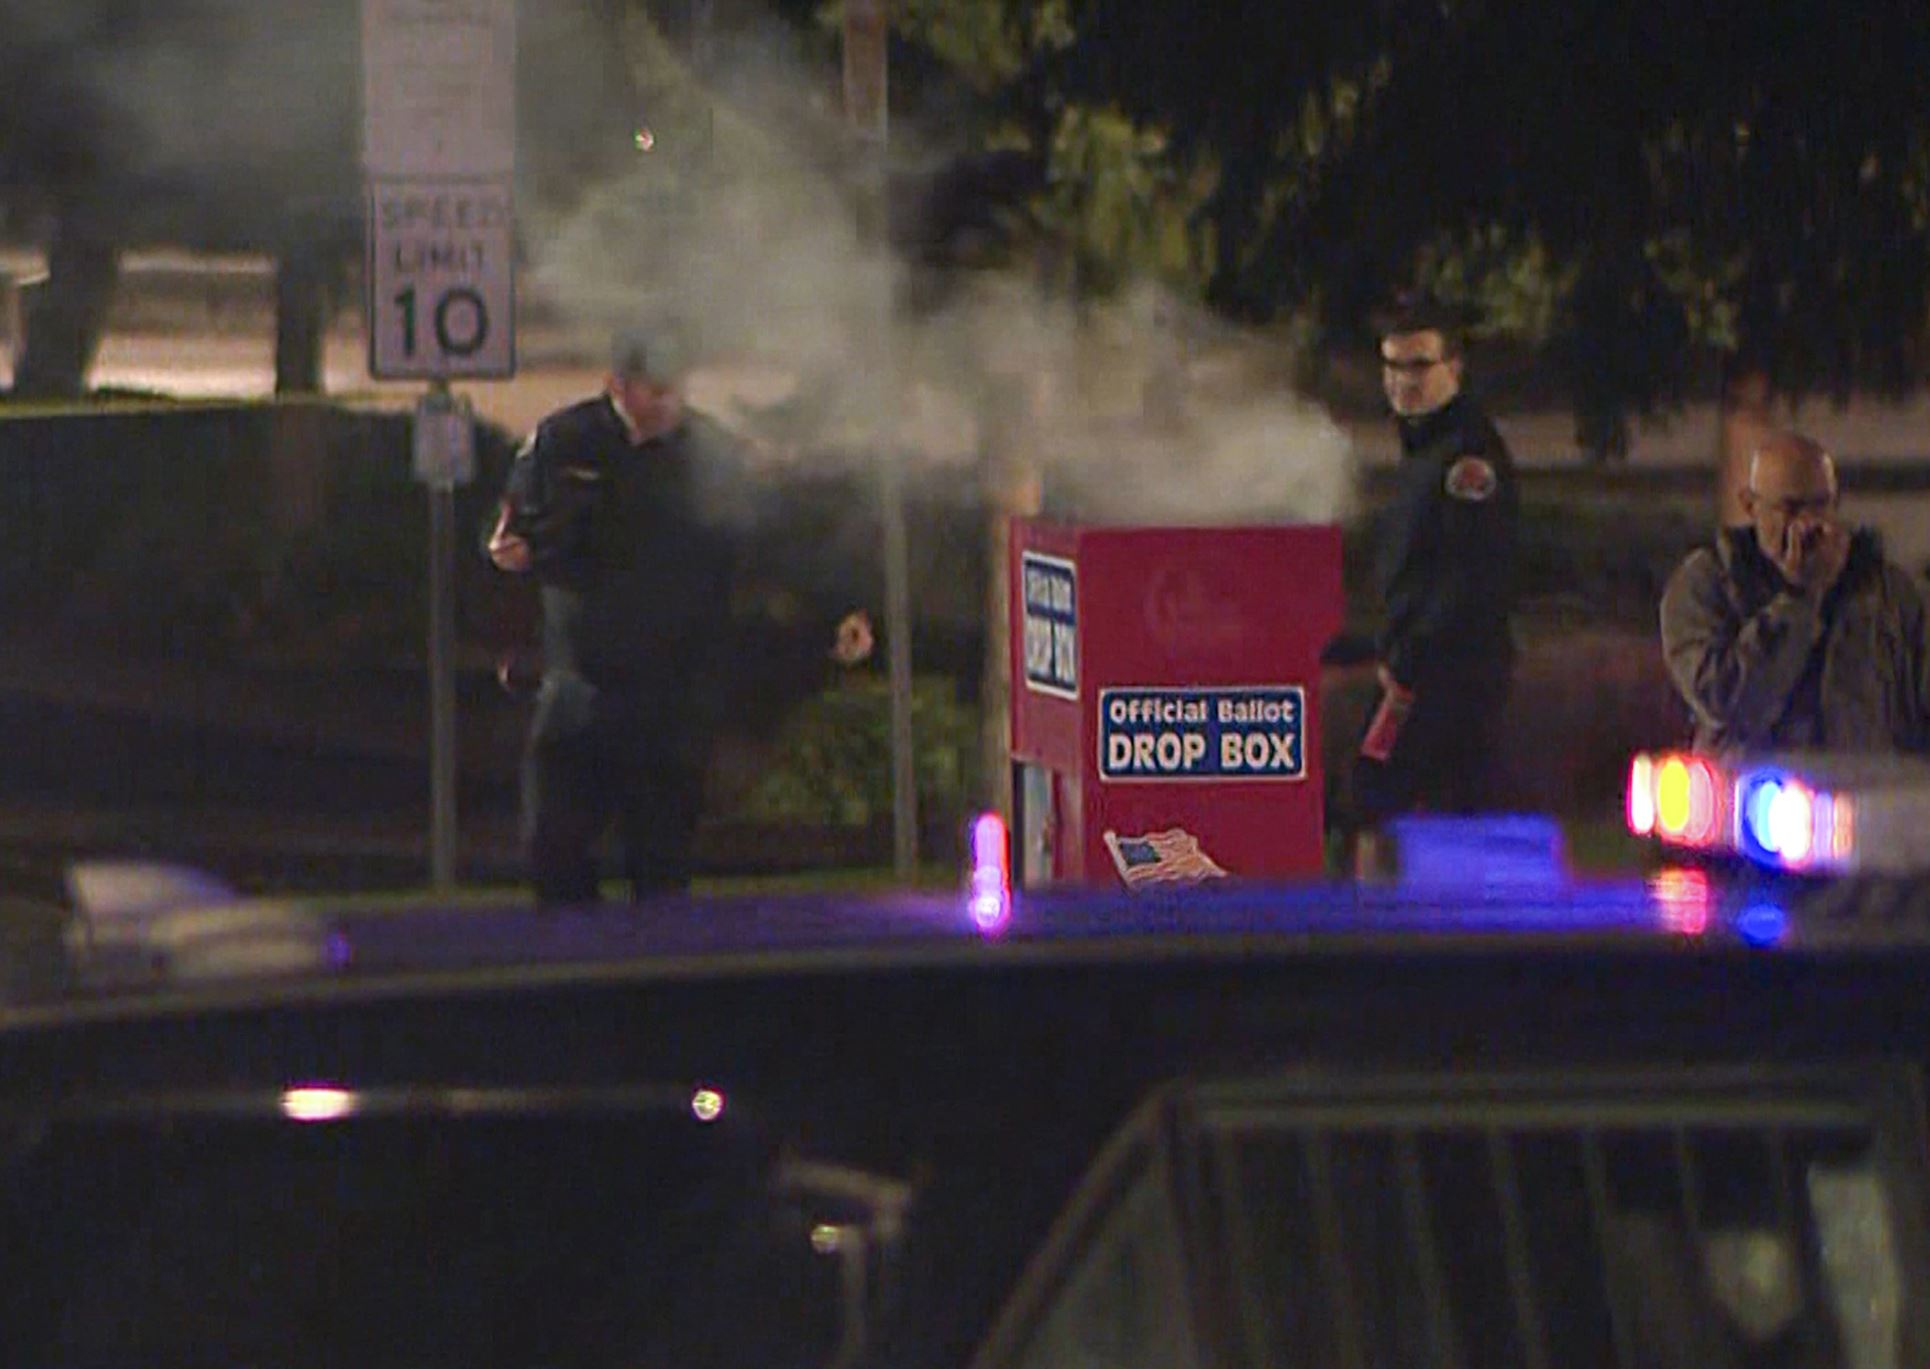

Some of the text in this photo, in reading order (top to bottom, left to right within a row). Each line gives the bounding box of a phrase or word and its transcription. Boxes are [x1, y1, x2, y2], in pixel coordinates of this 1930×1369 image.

[378, 197, 506, 230] SPEED
[393, 241, 488, 273] LIMIT
[394, 286, 489, 358] 10
[1109, 699, 1295, 724] Official Ballot
[1108, 733, 1295, 769] DROP BOX
